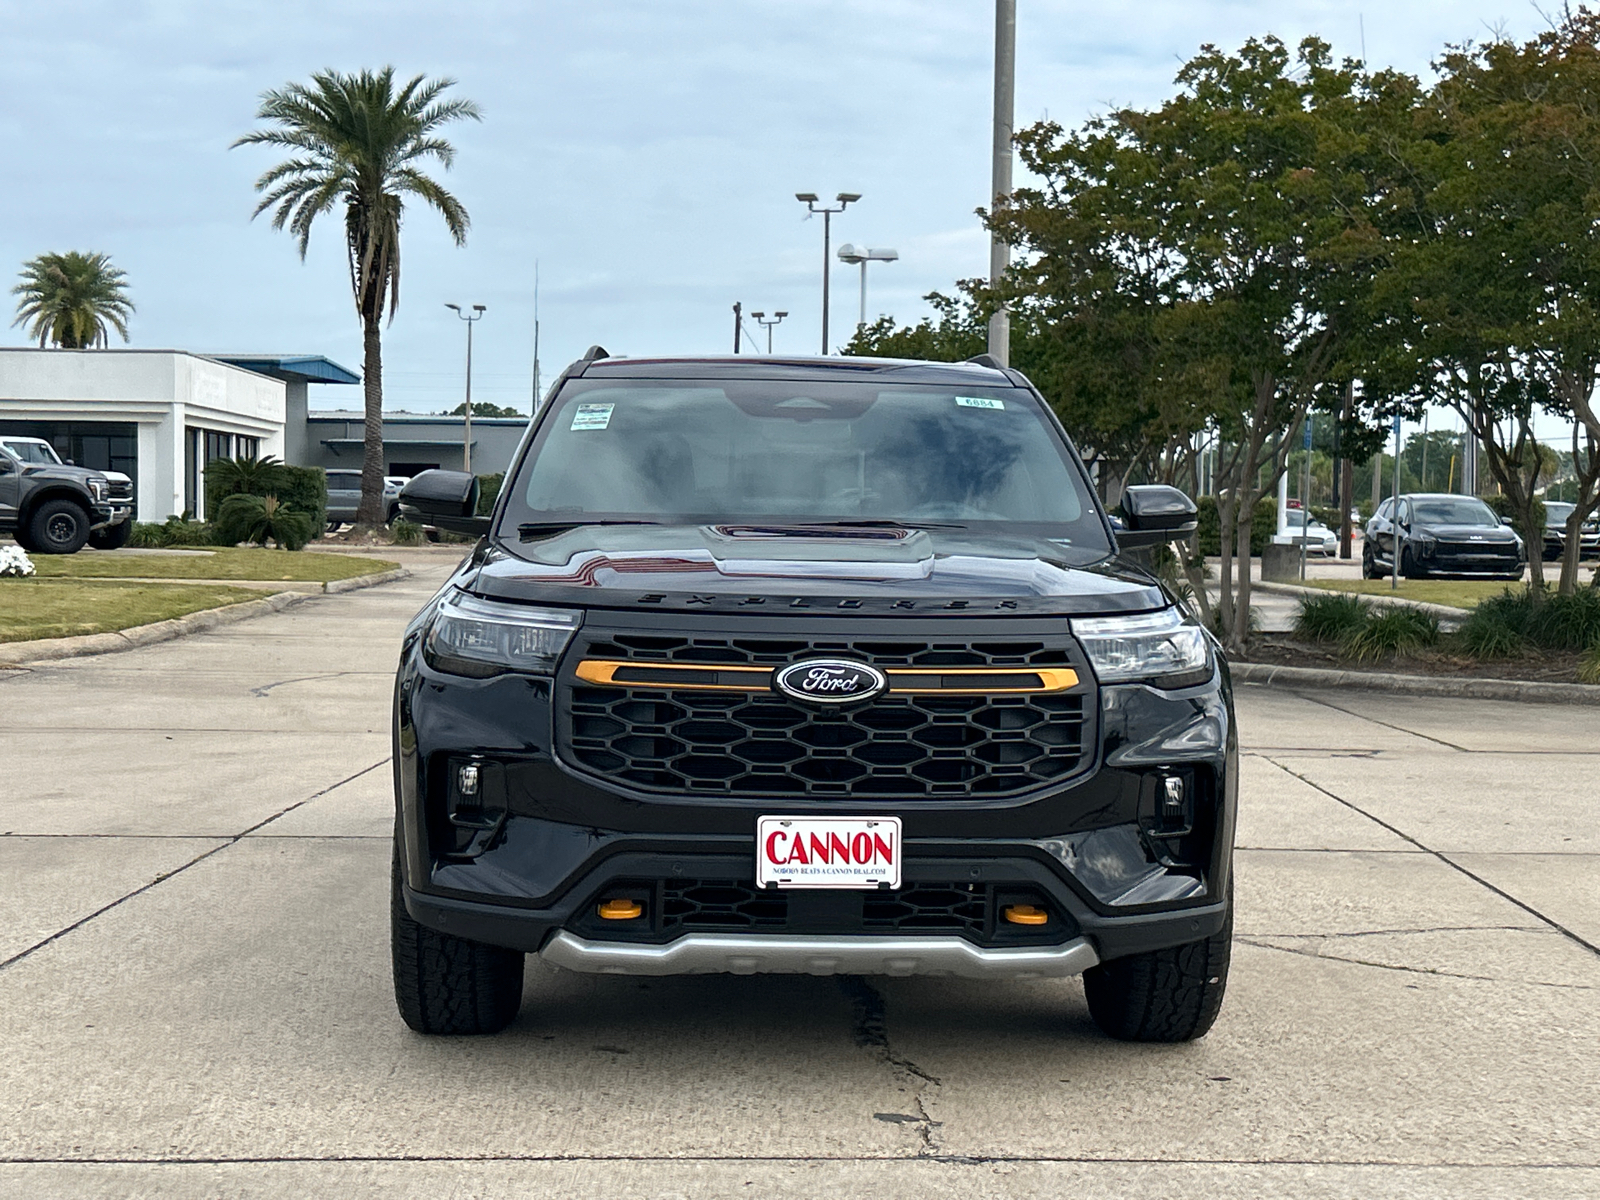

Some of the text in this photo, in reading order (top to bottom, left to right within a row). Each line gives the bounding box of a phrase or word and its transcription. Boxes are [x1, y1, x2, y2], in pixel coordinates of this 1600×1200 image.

[637, 593, 1019, 610] EXPLORER
[802, 667, 859, 691] Ford
[766, 830, 893, 865] CANNON
[772, 867, 799, 875] NOBODY
[801, 867, 820, 875] BEATS
